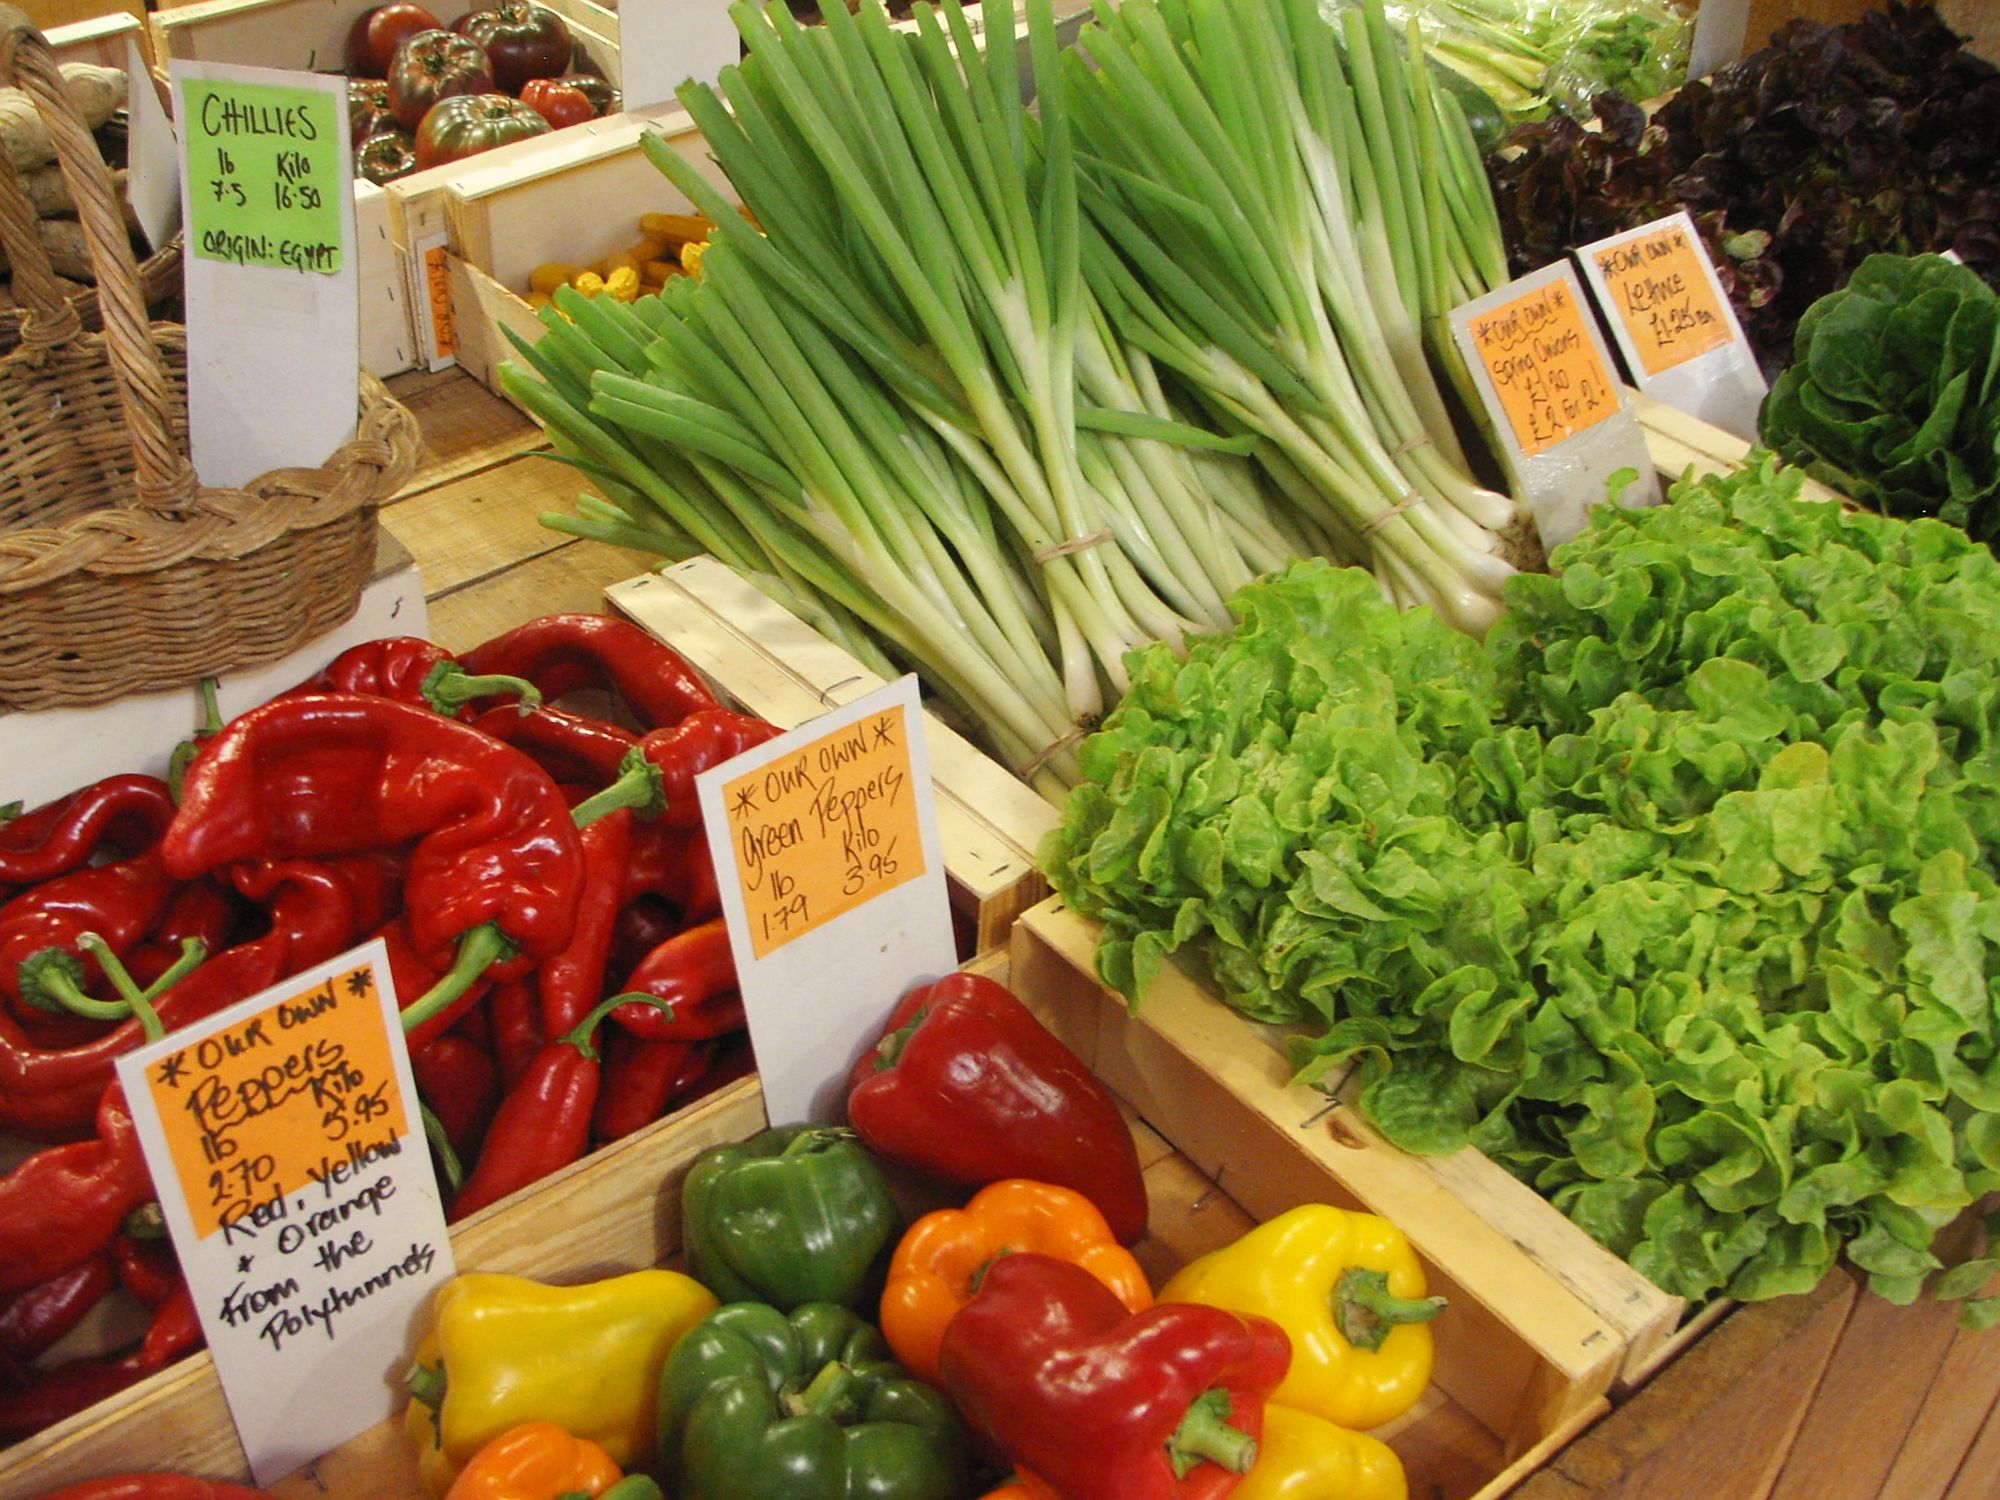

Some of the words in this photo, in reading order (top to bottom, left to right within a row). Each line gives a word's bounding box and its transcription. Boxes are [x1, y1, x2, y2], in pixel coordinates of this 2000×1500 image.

[202, 93, 317, 140] CHILLIES
[218, 147, 234, 175] lb
[277, 152, 311, 184] Kilo
[275, 182, 321, 210] 16.50
[203, 230, 274, 266] ORIGIN:
[280, 240, 338, 273] EGYPT
[820, 723, 867, 773] OWN
[809, 765, 903, 838] Peppers
[763, 894, 809, 940] 1.79
[843, 836, 897, 895] 3.95
[771, 870, 795, 901] lb
[843, 828, 879, 865] Kilo
[277, 977, 338, 1029] OWN
[200, 1132, 238, 1165] lb
[312, 1062, 364, 1110] Kilo
[209, 1154, 276, 1206] 2.70
[322, 1080, 389, 1141] 5.95
[278, 1175, 397, 1254] Orange
[313, 1230, 374, 1272] the
